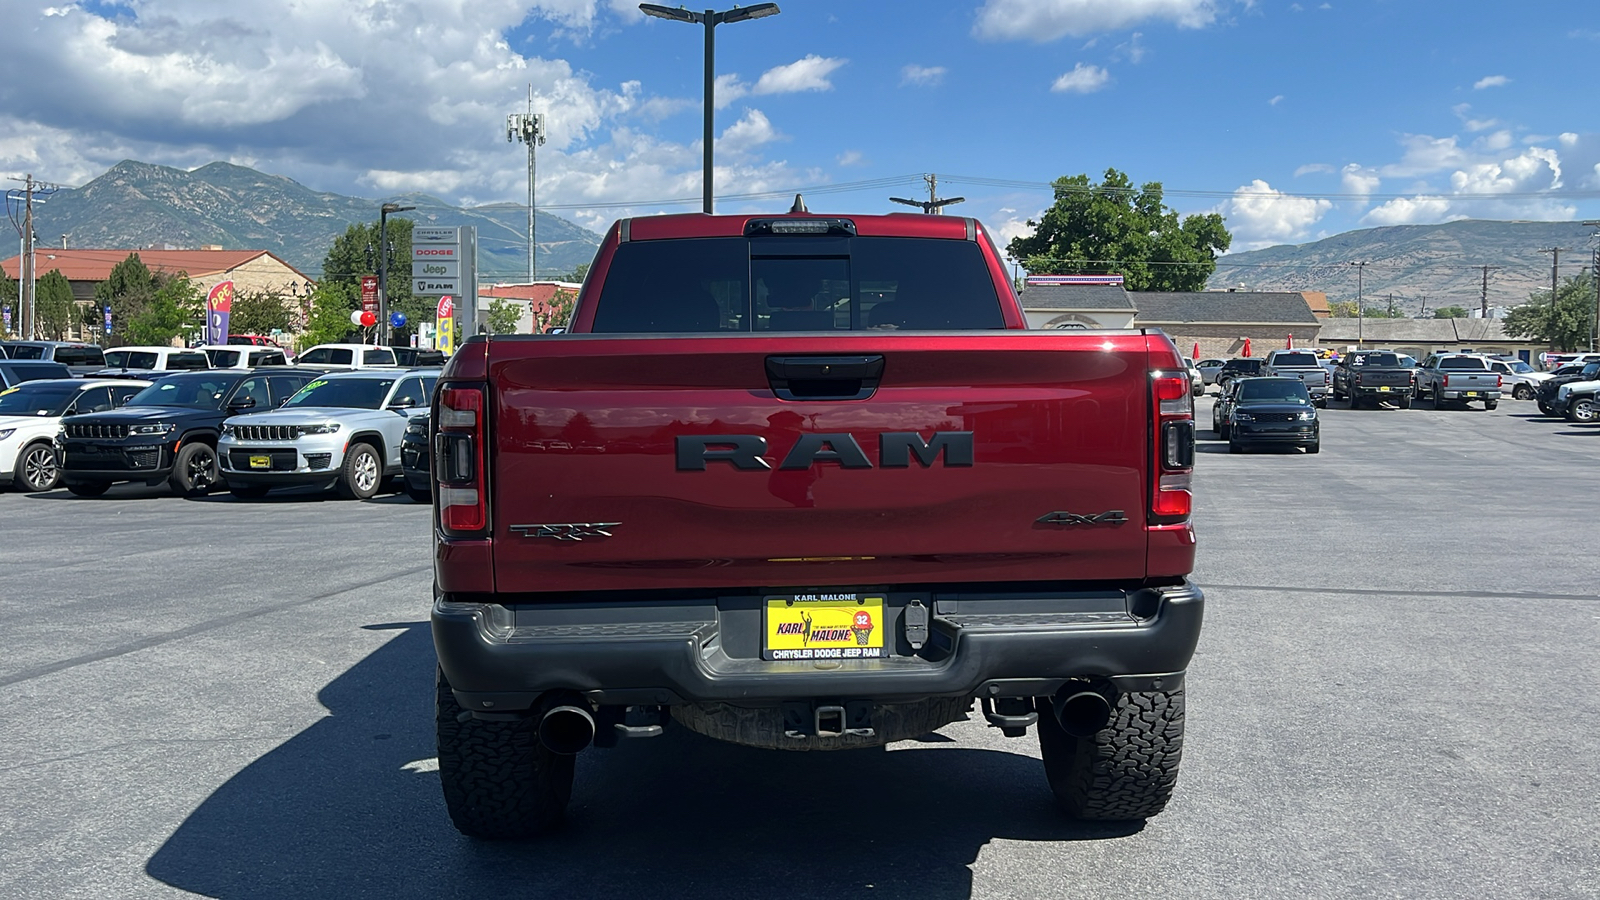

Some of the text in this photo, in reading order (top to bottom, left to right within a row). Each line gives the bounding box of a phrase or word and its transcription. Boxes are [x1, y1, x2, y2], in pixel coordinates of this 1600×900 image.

[423, 264, 447, 275] Jeep
[211, 284, 231, 310] PRE
[439, 298, 452, 317] USED
[675, 431, 974, 471] RAM
[509, 522, 622, 541] TRX
[794, 593, 857, 602] KARL MALONE
[856, 615, 868, 625] 32
[776, 622, 804, 635] KARL
[810, 629, 852, 642] MALONE
[773, 648, 880, 659] CHRYSLER DODGE JEEP RAM
